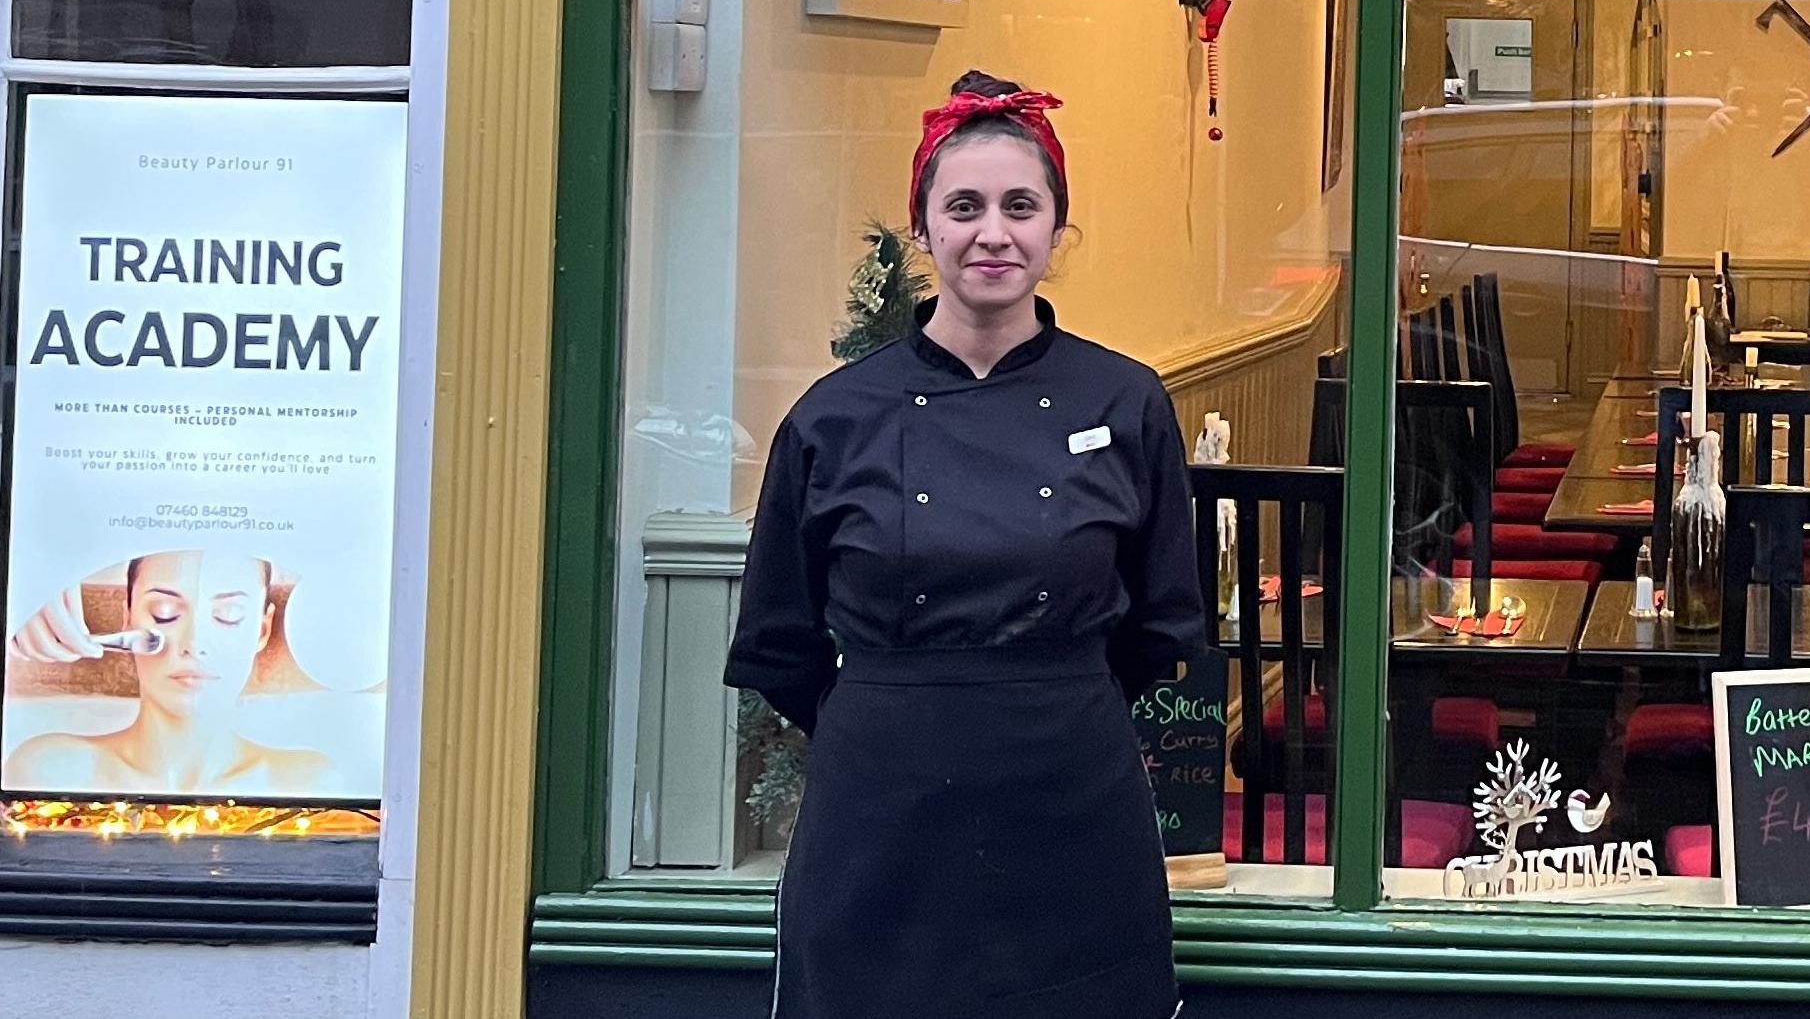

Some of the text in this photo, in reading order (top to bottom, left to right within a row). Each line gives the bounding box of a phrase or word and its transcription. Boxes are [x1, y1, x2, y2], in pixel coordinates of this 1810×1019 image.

[139, 155, 294, 172] Beauty Parlour 91
[80, 236, 345, 288] TRAINING
[29, 309, 381, 373] ACADEMY
[55, 403, 89, 413] MORE
[95, 404, 129, 413] THAN
[134, 404, 190, 415] COURSES
[207, 406, 272, 417] PERSONAL
[277, 408, 358, 418] MENTORSHIP
[174, 416, 238, 427] INCLUDED
[45, 447, 83, 459] Boost
[88, 450, 118, 461] your
[166, 451, 197, 462] grow
[203, 452, 233, 463] your
[320, 454, 344, 464] and
[349, 455, 377, 465] turn
[82, 461, 111, 472] your
[116, 461, 166, 472] passion
[171, 462, 198, 472] into
[203, 464, 210, 472] a
[215, 464, 258, 473] career
[302, 464, 331, 475] love
[156, 505, 199, 517] 07460
[1160, 729, 1219, 751] Curry
